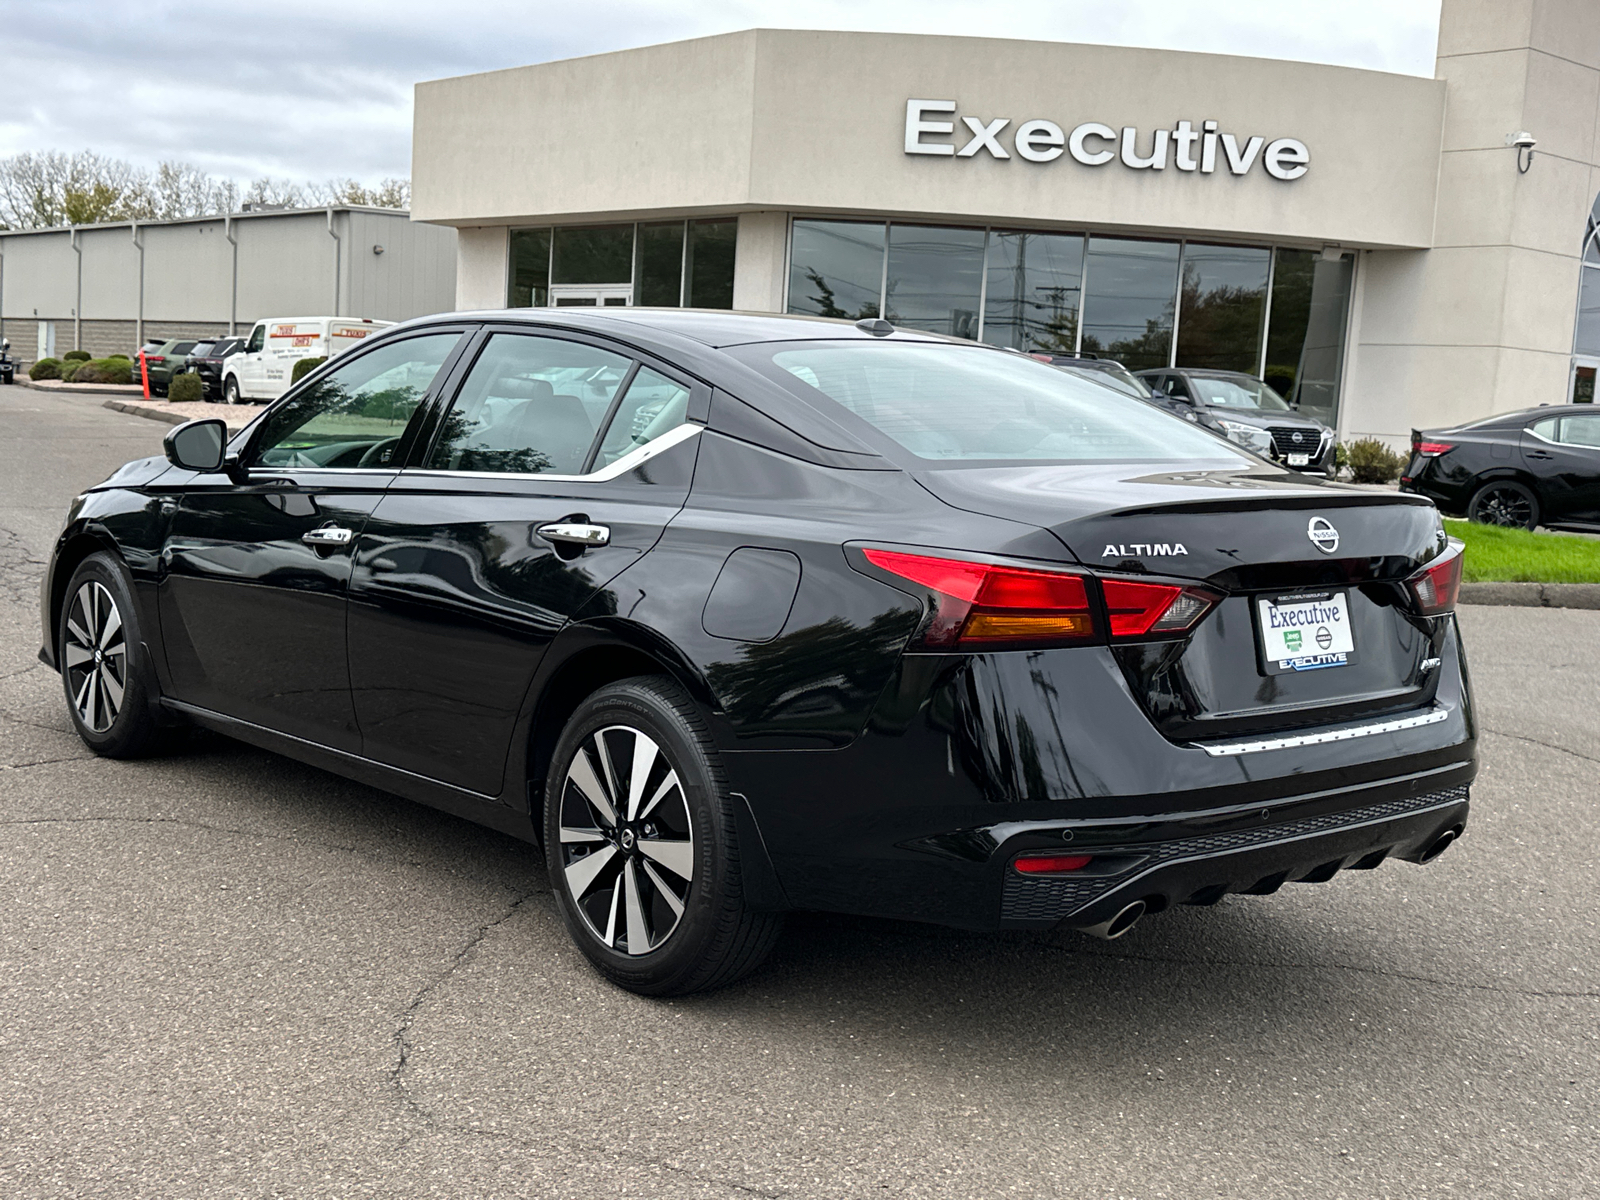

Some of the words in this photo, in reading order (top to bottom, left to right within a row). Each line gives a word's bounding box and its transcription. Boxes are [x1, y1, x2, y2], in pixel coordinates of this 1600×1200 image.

[904, 98, 1310, 182] Executive
[1313, 531, 1338, 539] NISSAN
[1102, 543, 1188, 558] ALTIMA
[1268, 601, 1341, 628] Executive
[1286, 632, 1300, 641] Jeep
[1278, 653, 1348, 670] EXECUTIVE
